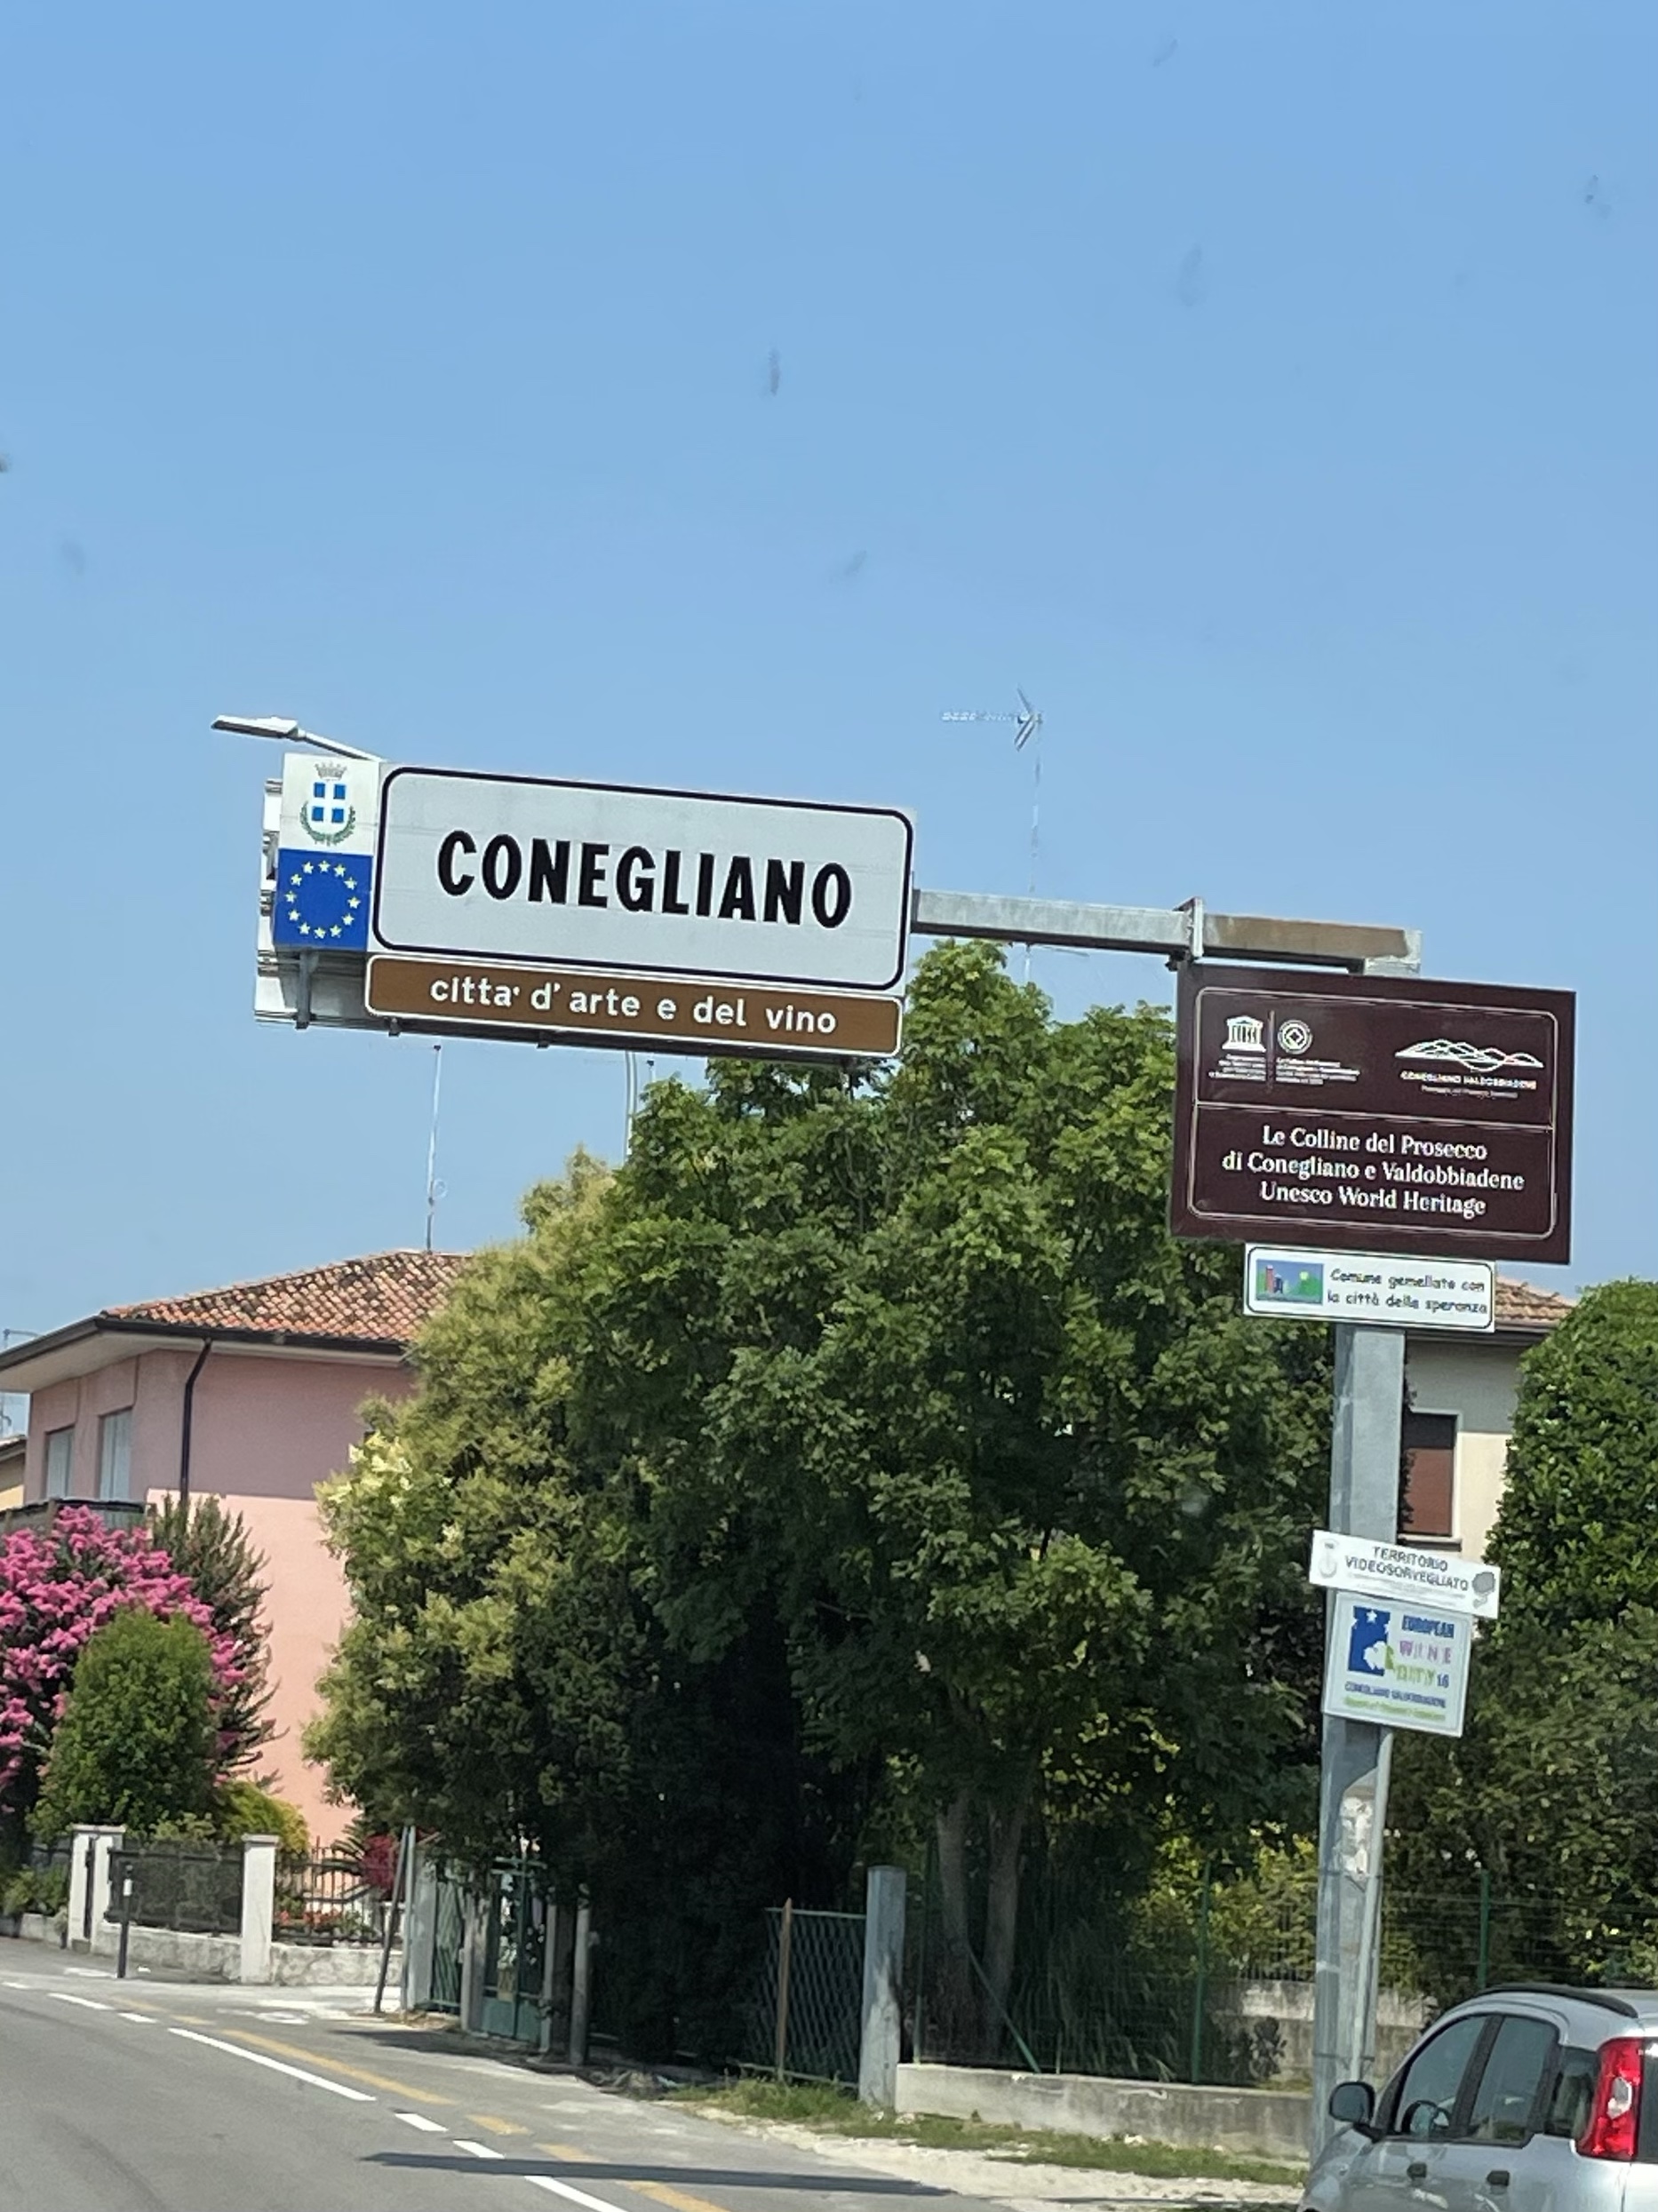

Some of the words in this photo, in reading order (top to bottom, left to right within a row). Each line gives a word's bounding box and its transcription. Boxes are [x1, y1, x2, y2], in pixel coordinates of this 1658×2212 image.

[436, 830, 852, 929] CONEGLIANO
[656, 998, 677, 1021] e
[692, 994, 747, 1027] del
[765, 1004, 837, 1034] vino
[1262, 1124, 1286, 1147] Le
[1289, 1126, 1361, 1151] Colline
[1365, 1132, 1395, 1154] del
[1400, 1134, 1488, 1161] Prosecco
[1221, 1150, 1243, 1171] di
[1247, 1151, 1360, 1181] Conegliano
[1364, 1164, 1377, 1181] e
[1381, 1160, 1526, 1191] Valdobbiadene
[1260, 1180, 1334, 1205] Unesco
[1337, 1185, 1398, 1209] World
[1402, 1190, 1487, 1220] Heritage
[1329, 1268, 1383, 1285] Comune
[1387, 1274, 1456, 1290] gemellato
[1461, 1280, 1486, 1293] con
[1327, 1289, 1340, 1303] la
[1345, 1291, 1380, 1307] città
[1385, 1293, 1420, 1310] della
[1424, 1297, 1488, 1315] speranza
[1344, 1555, 1469, 1592] VIDEOSORVEGLIATO
[1373, 1546, 1449, 1572] TERRITORIO
[1399, 1640, 1452, 1665] WINE
